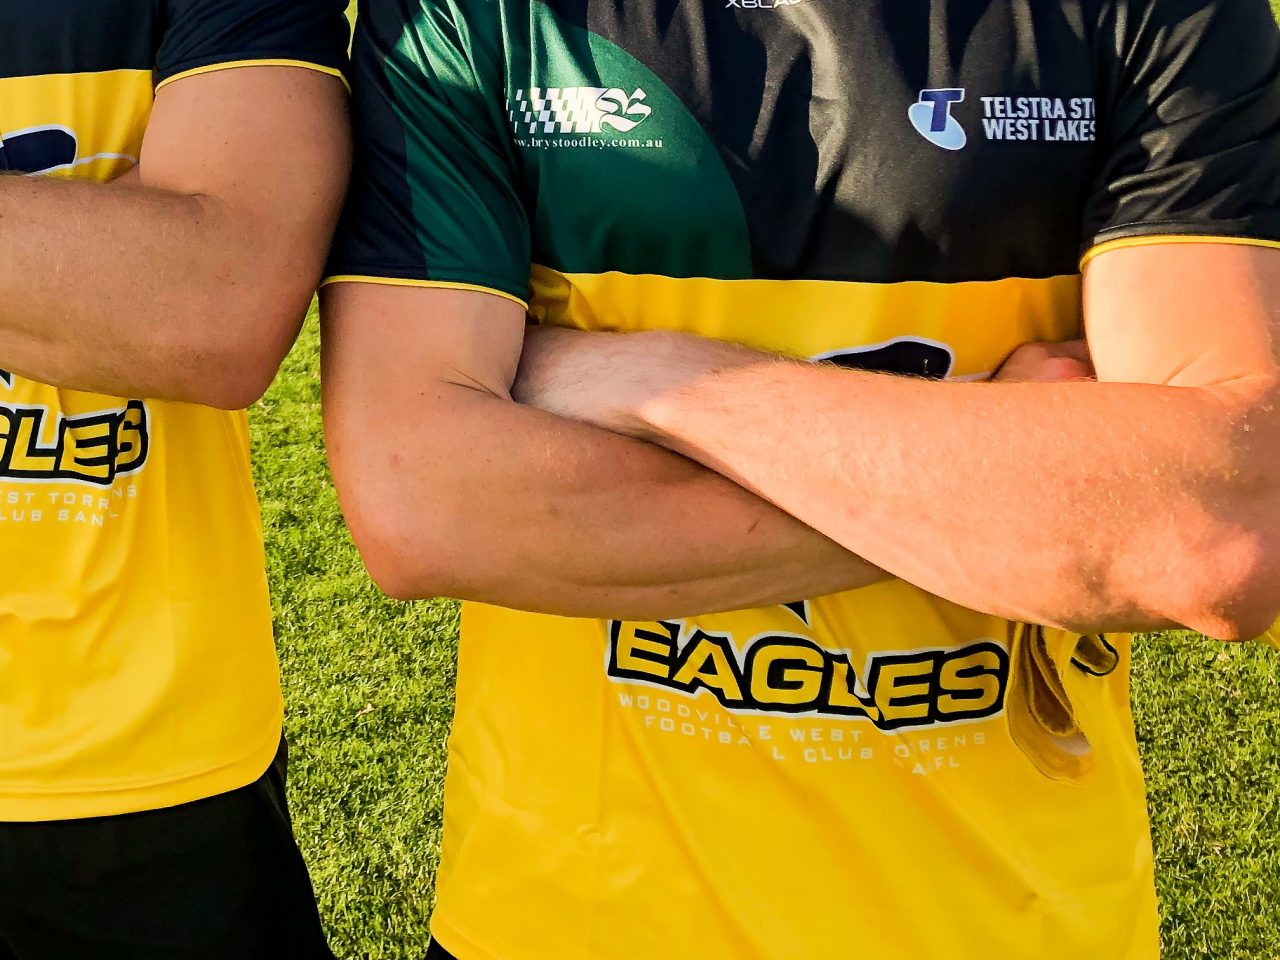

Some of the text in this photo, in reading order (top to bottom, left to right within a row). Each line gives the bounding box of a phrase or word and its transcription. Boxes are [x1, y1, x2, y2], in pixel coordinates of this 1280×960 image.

[980, 96, 1067, 119] TELSTRA
[981, 119, 1040, 141] WEST
[606, 618, 1009, 731] EAGLES
[644, 715, 786, 761] FOOTBAL
[803, 747, 874, 763] CLUB
[789, 727, 863, 743] WEST
